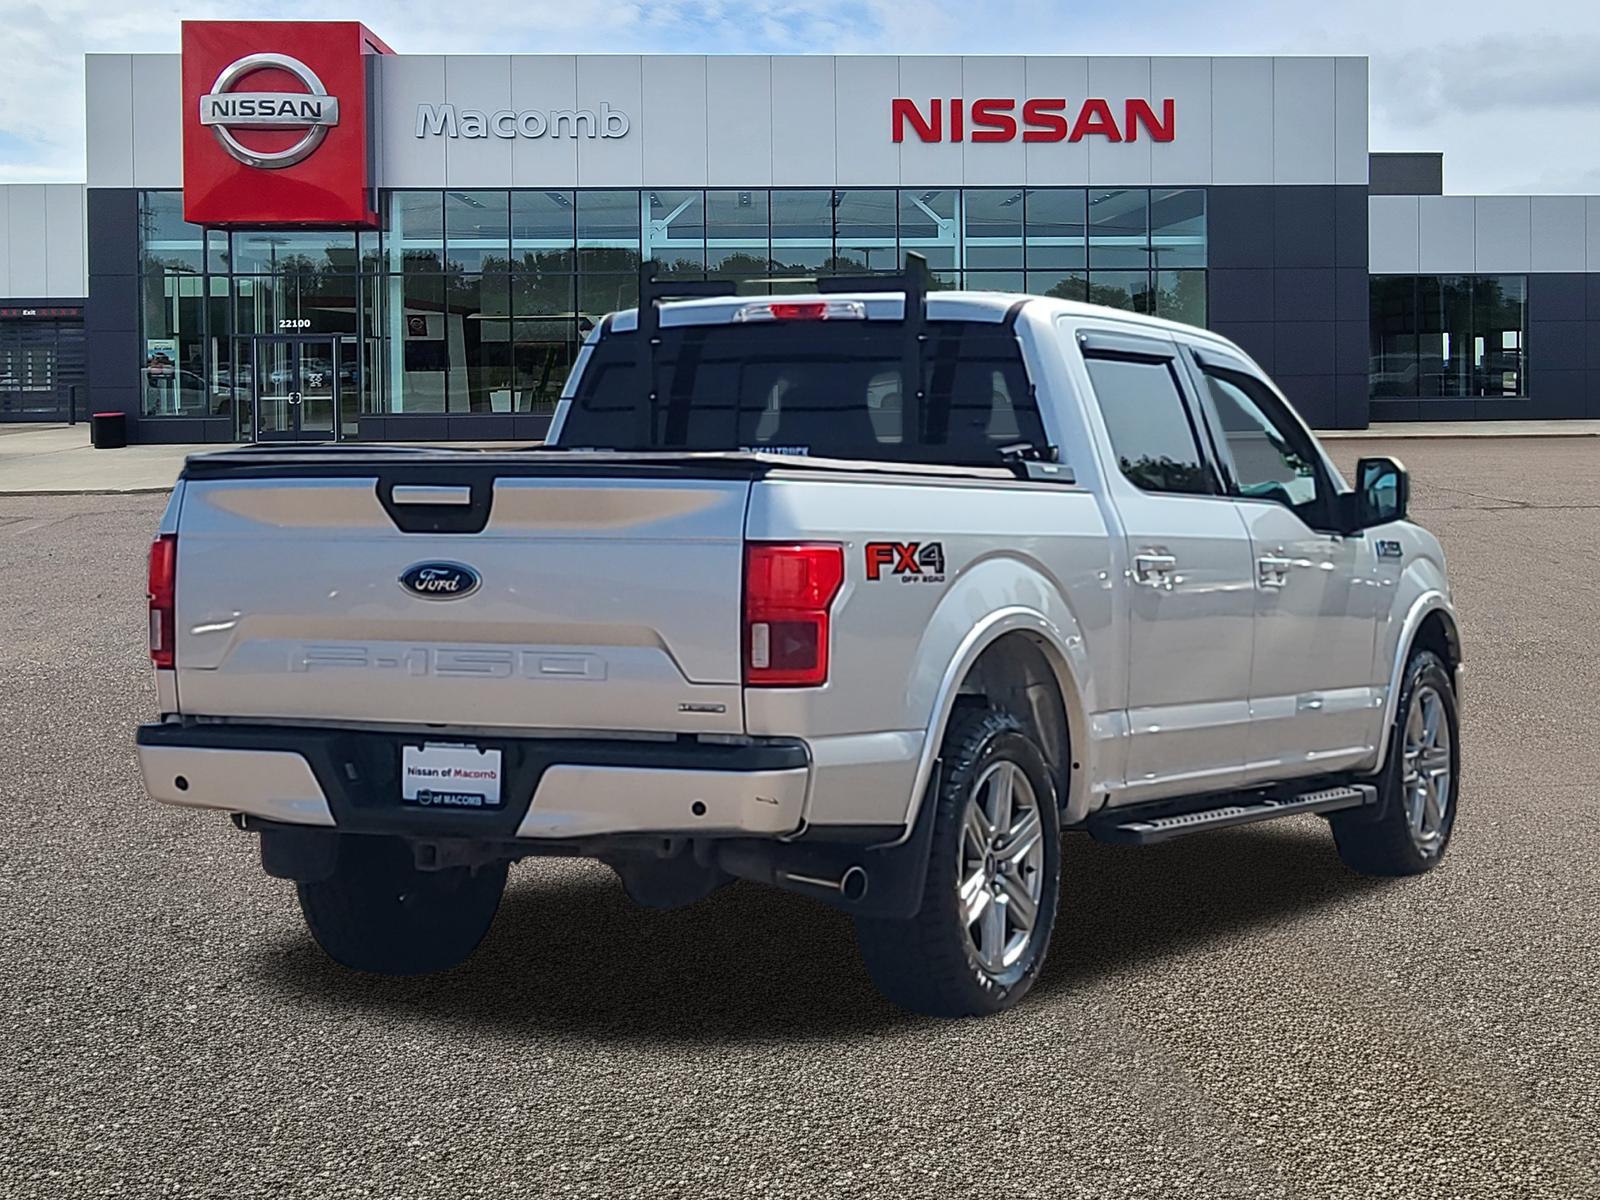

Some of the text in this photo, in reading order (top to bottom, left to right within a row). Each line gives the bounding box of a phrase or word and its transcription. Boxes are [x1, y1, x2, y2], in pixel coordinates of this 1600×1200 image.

[212, 100, 322, 118] NISSAN
[415, 102, 630, 139] Macomb
[892, 98, 1175, 143] NISSAN
[279, 319, 311, 328] 22100
[865, 541, 945, 581] FX4
[415, 568, 460, 591] Ford
[288, 645, 607, 681] F-150
[407, 766, 497, 780] Nissan of Macomb
